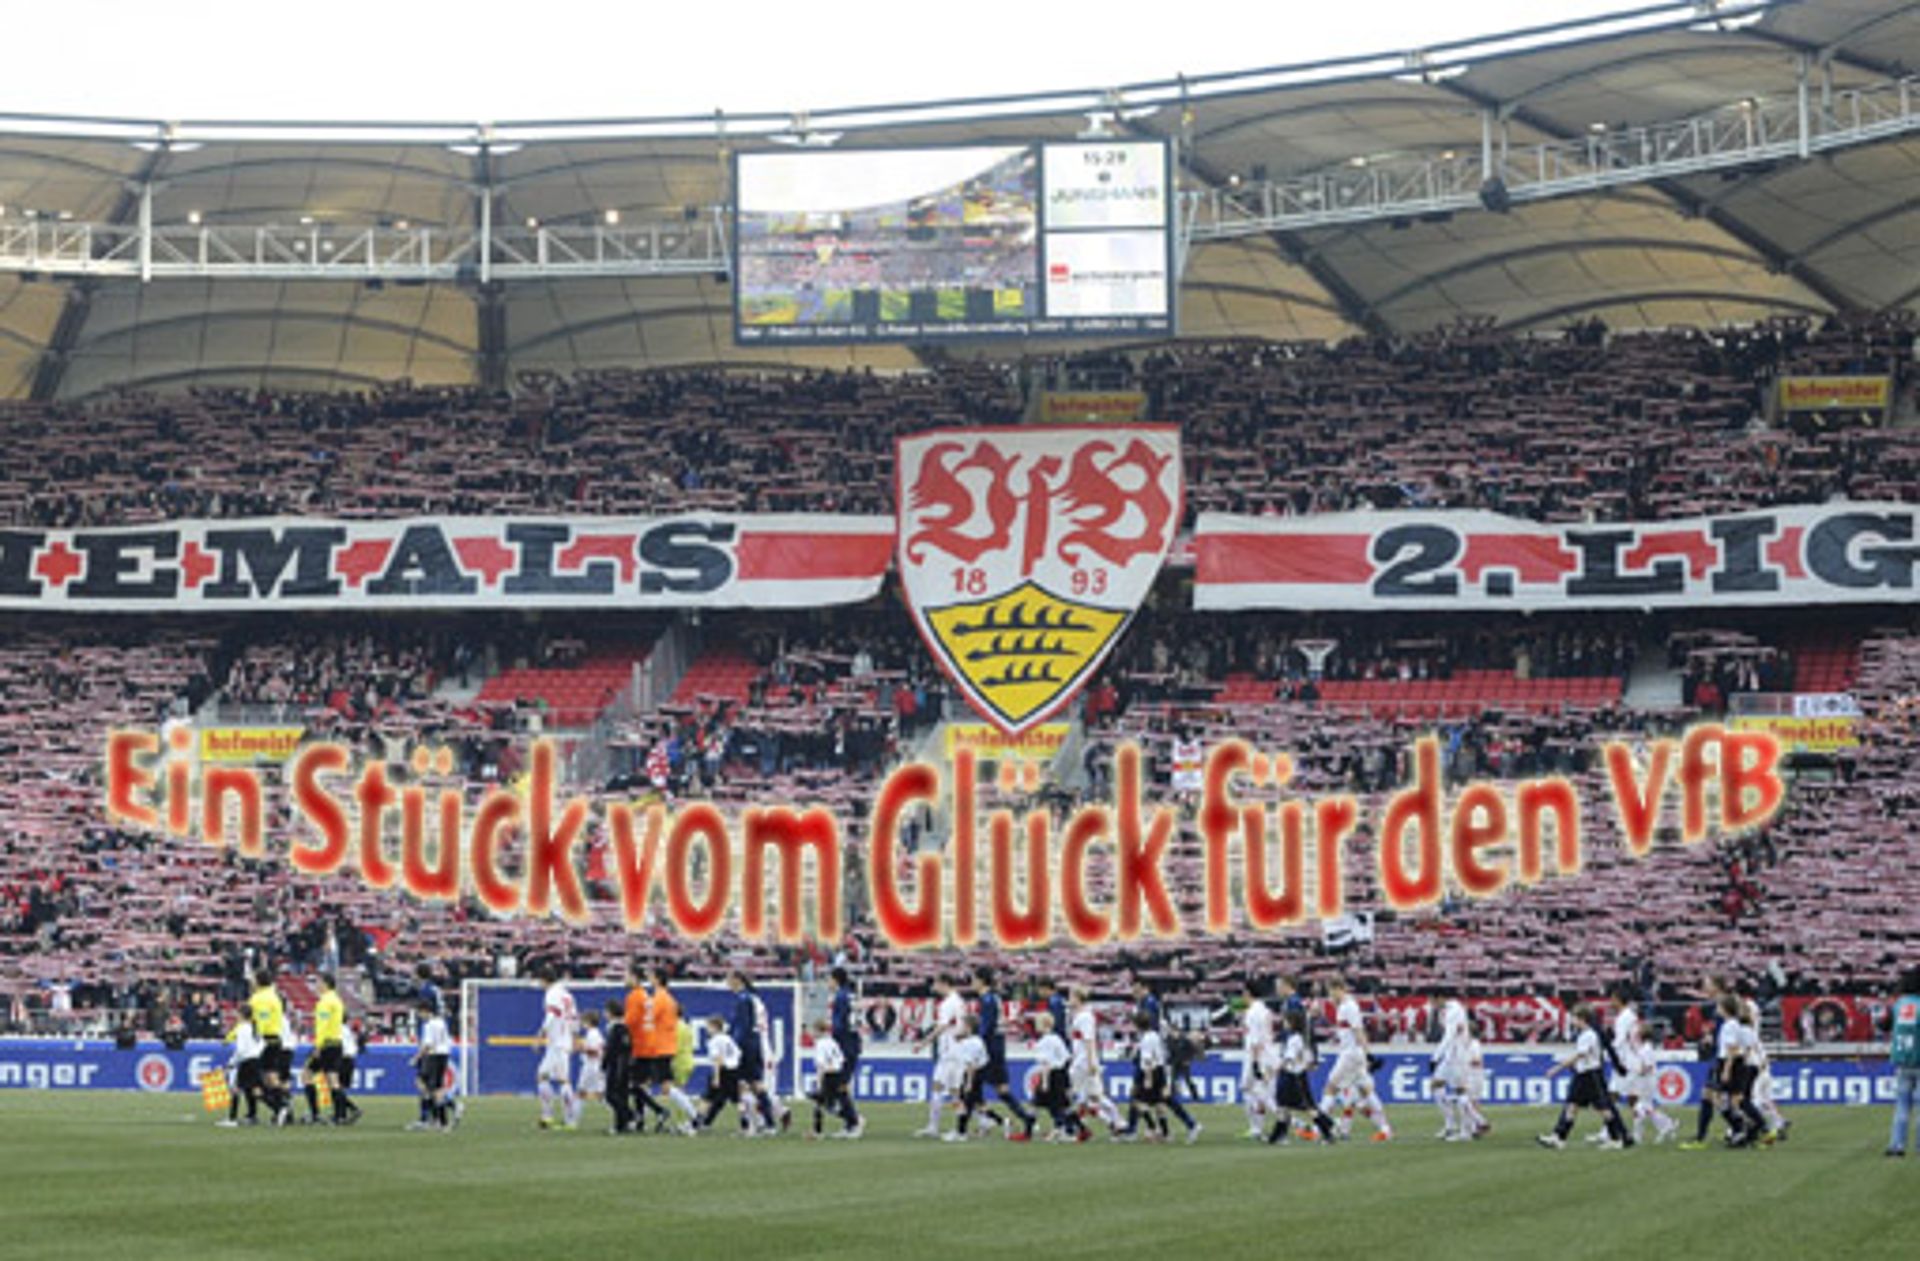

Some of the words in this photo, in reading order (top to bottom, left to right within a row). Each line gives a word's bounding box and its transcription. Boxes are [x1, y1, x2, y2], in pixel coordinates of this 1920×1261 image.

[951, 568, 988, 595] 18
[1070, 566, 1109, 595] 93
[1371, 523, 1514, 597] 2.
